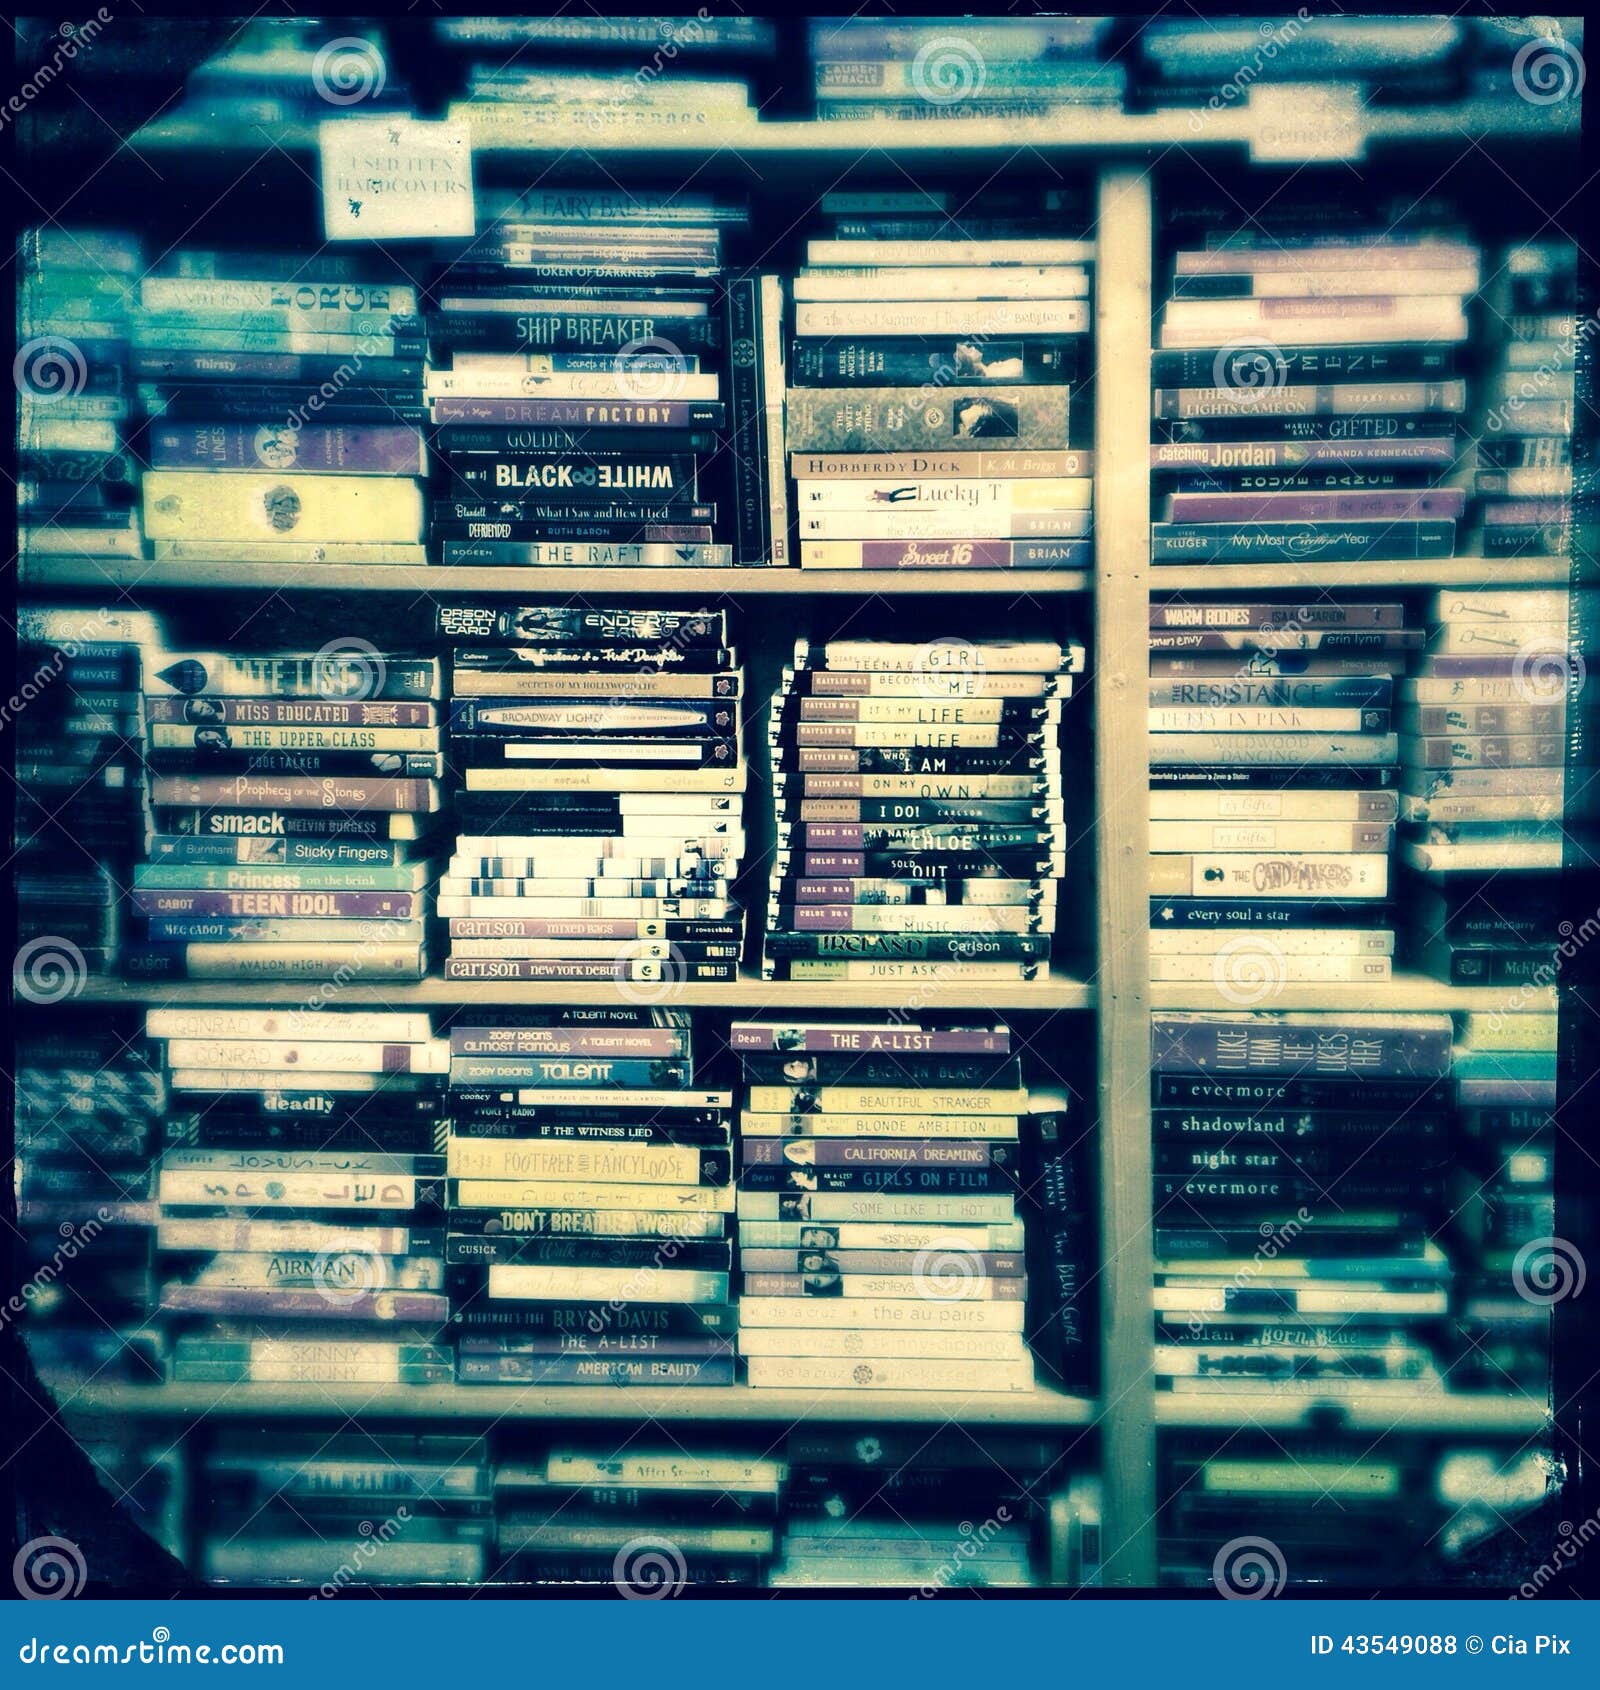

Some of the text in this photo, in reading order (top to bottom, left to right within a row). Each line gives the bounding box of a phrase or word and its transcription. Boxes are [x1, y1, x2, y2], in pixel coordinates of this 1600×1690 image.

[825, 65, 877, 73] LAUREN
[825, 74, 878, 84] MYRACLE
[543, 196, 594, 218] FAIRY
[536, 267, 656, 278] TOKEN OF DARKNESS
[271, 286, 390, 312] FORGE
[516, 318, 655, 345] SHIP BREAKER
[194, 360, 237, 371] Thirsty
[1232, 354, 1387, 373] TORMENT
[505, 408, 580, 422] DREAM
[585, 407, 671, 422] FACTORY
[1187, 402, 1306, 415] LIGHTS CAME ON
[1330, 420, 1398, 437] GIFTED
[195, 429, 209, 456] TAN
[213, 427, 225, 461] LINES
[508, 431, 575, 448] GOLDEN
[1160, 447, 1208, 462] Catching
[1212, 445, 1276, 466] Jordan
[1368, 448, 1424, 457] KENNEALLY
[809, 459, 960, 473] HOBBERDY DICK
[496, 466, 673, 487] BLACK WHITE
[917, 484, 981, 505] Lucky
[536, 507, 563, 518] What
[565, 507, 568, 517] I
[571, 508, 591, 517] Saw
[594, 507, 612, 517] and
[615, 507, 637, 518] How
[647, 508, 668, 517] Lied
[469, 524, 511, 538] DEFRIENDED
[1167, 538, 1207, 548] KLUGER
[1233, 534, 1370, 546] My Most Year
[534, 546, 643, 562] THE RAFT
[899, 544, 1070, 566] Sweet 16 BRIAN
[441, 609, 496, 617] ORSON
[585, 614, 679, 627] ENDER'S
[1165, 609, 1250, 625] WARM BODIES
[441, 617, 495, 627] SCOTT
[445, 626, 490, 635] CARD
[1177, 636, 1203, 646] envy
[1327, 633, 1381, 645] erin lynn
[929, 651, 984, 666] GIRL
[73, 671, 117, 679] PRIVATE
[949, 682, 974, 695] ME
[1181, 685, 1322, 703] RESISTANCE
[236, 704, 349, 722] MISS EDUCATED
[502, 713, 561, 723] BROADWAY
[919, 709, 964, 722] LIFE
[244, 731, 376, 747] THE UPPER CLASS
[884, 752, 946, 772] WHO I AM
[236, 776, 365, 806] Prophecy Stones
[874, 780, 892, 789] ON
[921, 785, 970, 798] OWN
[880, 805, 919, 818] I DO!
[211, 812, 376, 834] smack MELVIN BURGESS
[911, 836, 972, 850] CHLOE
[187, 844, 388, 860] Burnham Sticky Fingers
[228, 872, 376, 888] Princess on the brink
[159, 895, 341, 915] CABOT TEEN IDOL
[1188, 909, 1291, 924] every soul a star
[457, 921, 525, 935] carlson
[905, 922, 950, 932] MUSIC
[1466, 921, 1535, 930] Katie McGarry
[823, 935, 1000, 954] IRELAND Carlson
[240, 960, 323, 970] AVALON HIGH
[451, 961, 520, 977] carlson
[870, 965, 937, 975] JUST ASK
[176, 1015, 250, 1033] CONRAD
[625, 1038, 652, 1046] NOVEL
[738, 1034, 934, 1049] Dean THE A-LIST
[1217, 1031, 1247, 1061] LIKE
[195, 1047, 271, 1064] CONRAD
[1284, 1043, 1314, 1060] HE
[1317, 1033, 1349, 1072] LIKES
[1350, 1040, 1384, 1066] HER
[460, 1093, 491, 1101] cooney
[1191, 1085, 1285, 1097] evermore
[264, 1096, 335, 1113] deadly
[860, 1097, 991, 1108] BEAUTIFUL STRANGER
[541, 1126, 653, 1137] IF THE WITNESS LIED
[856, 1120, 986, 1133] BLONDE AMBITION
[1182, 1117, 1285, 1133] shadowland
[844, 1148, 983, 1161] CALIFORNIA DREAMING
[1192, 1150, 1278, 1169] night star
[504, 1152, 686, 1179] FOOTFREE FANCYLOOSE
[863, 1172, 988, 1186] GIRLS ON FILM
[1186, 1182, 1279, 1194] evermore
[500, 1211, 544, 1231] DON'T
[458, 1245, 496, 1255] CUSICK
[266, 1258, 356, 1281] AIRMAN
[1056, 1264, 1081, 1345] BLUE GIRL
[618, 1311, 668, 1328] DAVIS
[873, 1307, 985, 1323] the au pairs
[599, 1335, 659, 1349] A-LIST
[291, 1348, 359, 1362] SKINNY
[291, 1365, 359, 1380] SKINNY
[577, 1363, 700, 1376] AMERICAN BEAUTY
